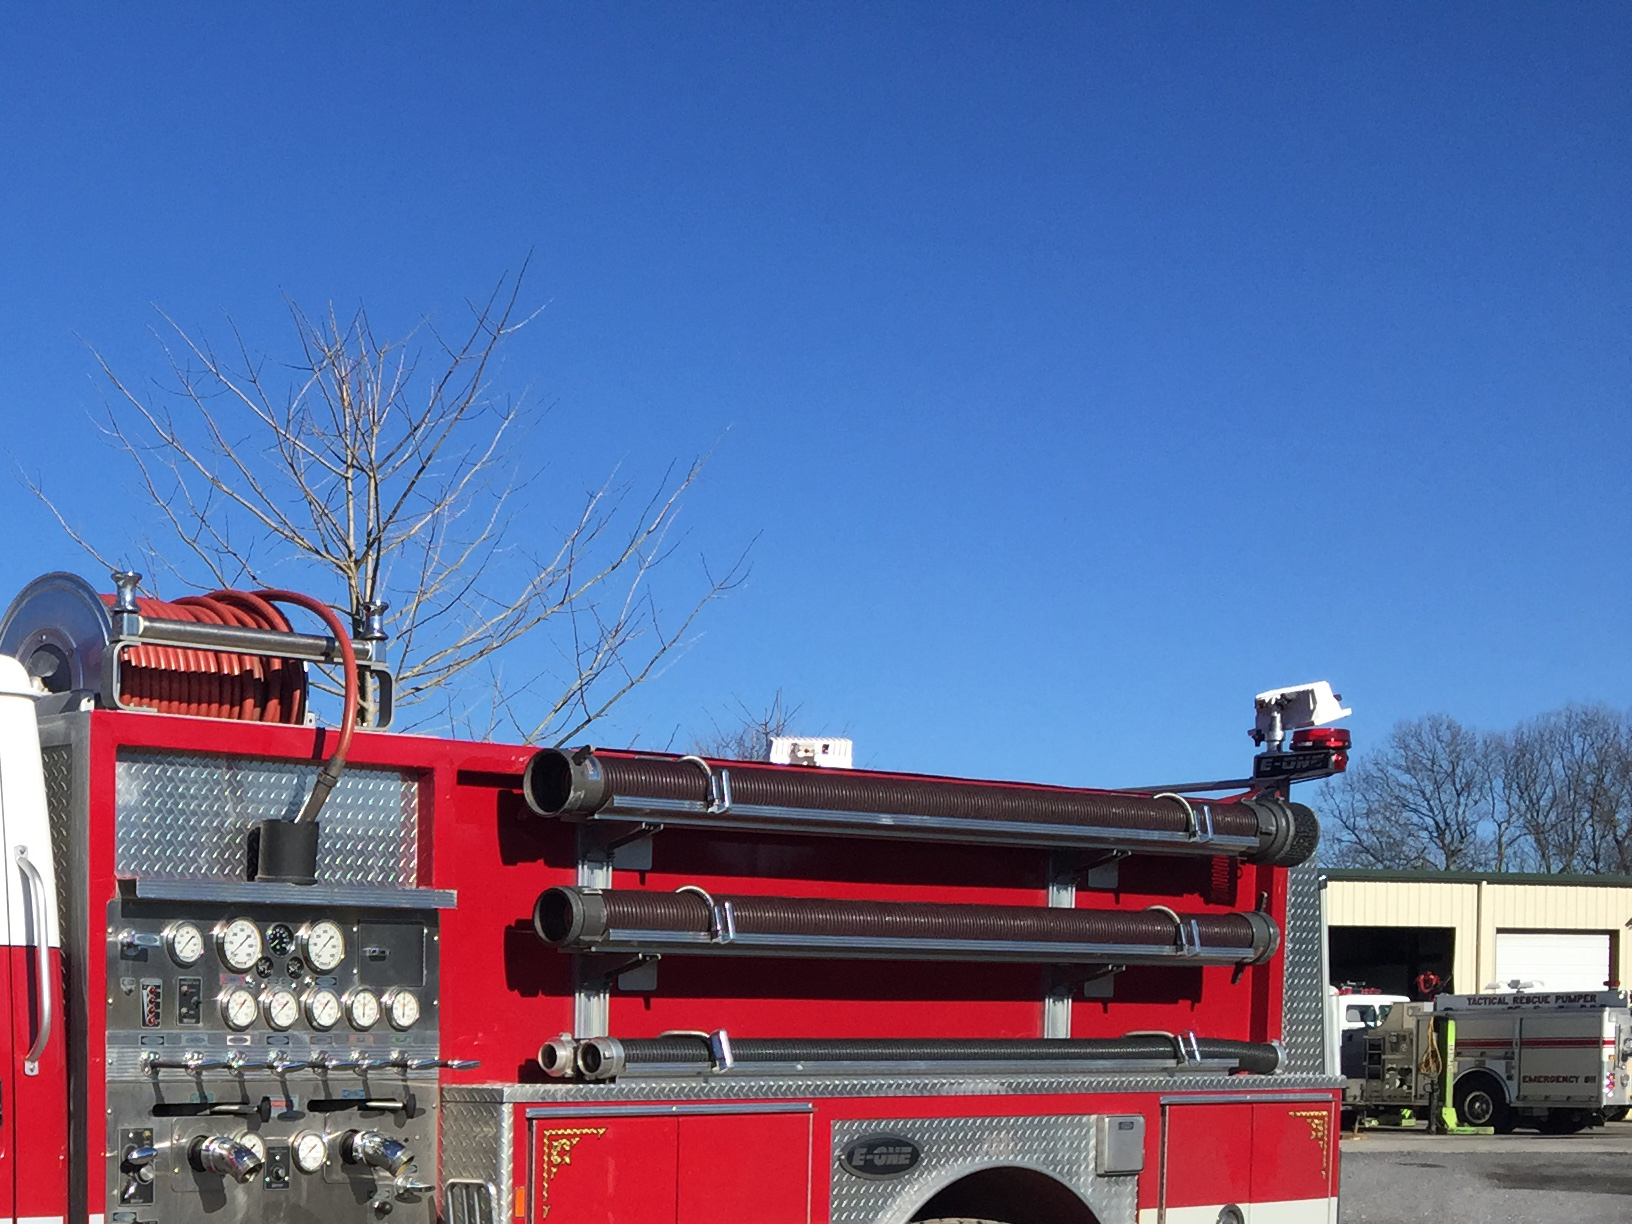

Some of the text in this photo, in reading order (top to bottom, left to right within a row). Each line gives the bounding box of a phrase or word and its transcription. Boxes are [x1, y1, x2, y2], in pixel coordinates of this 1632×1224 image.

[1260, 754, 1324, 771] E-ONE
[1467, 994, 1597, 1006] TACTICAL RESCUE PUMPER
[1522, 1075, 1581, 1084] EMERGENCY
[851, 1146, 913, 1166] E-ONE
